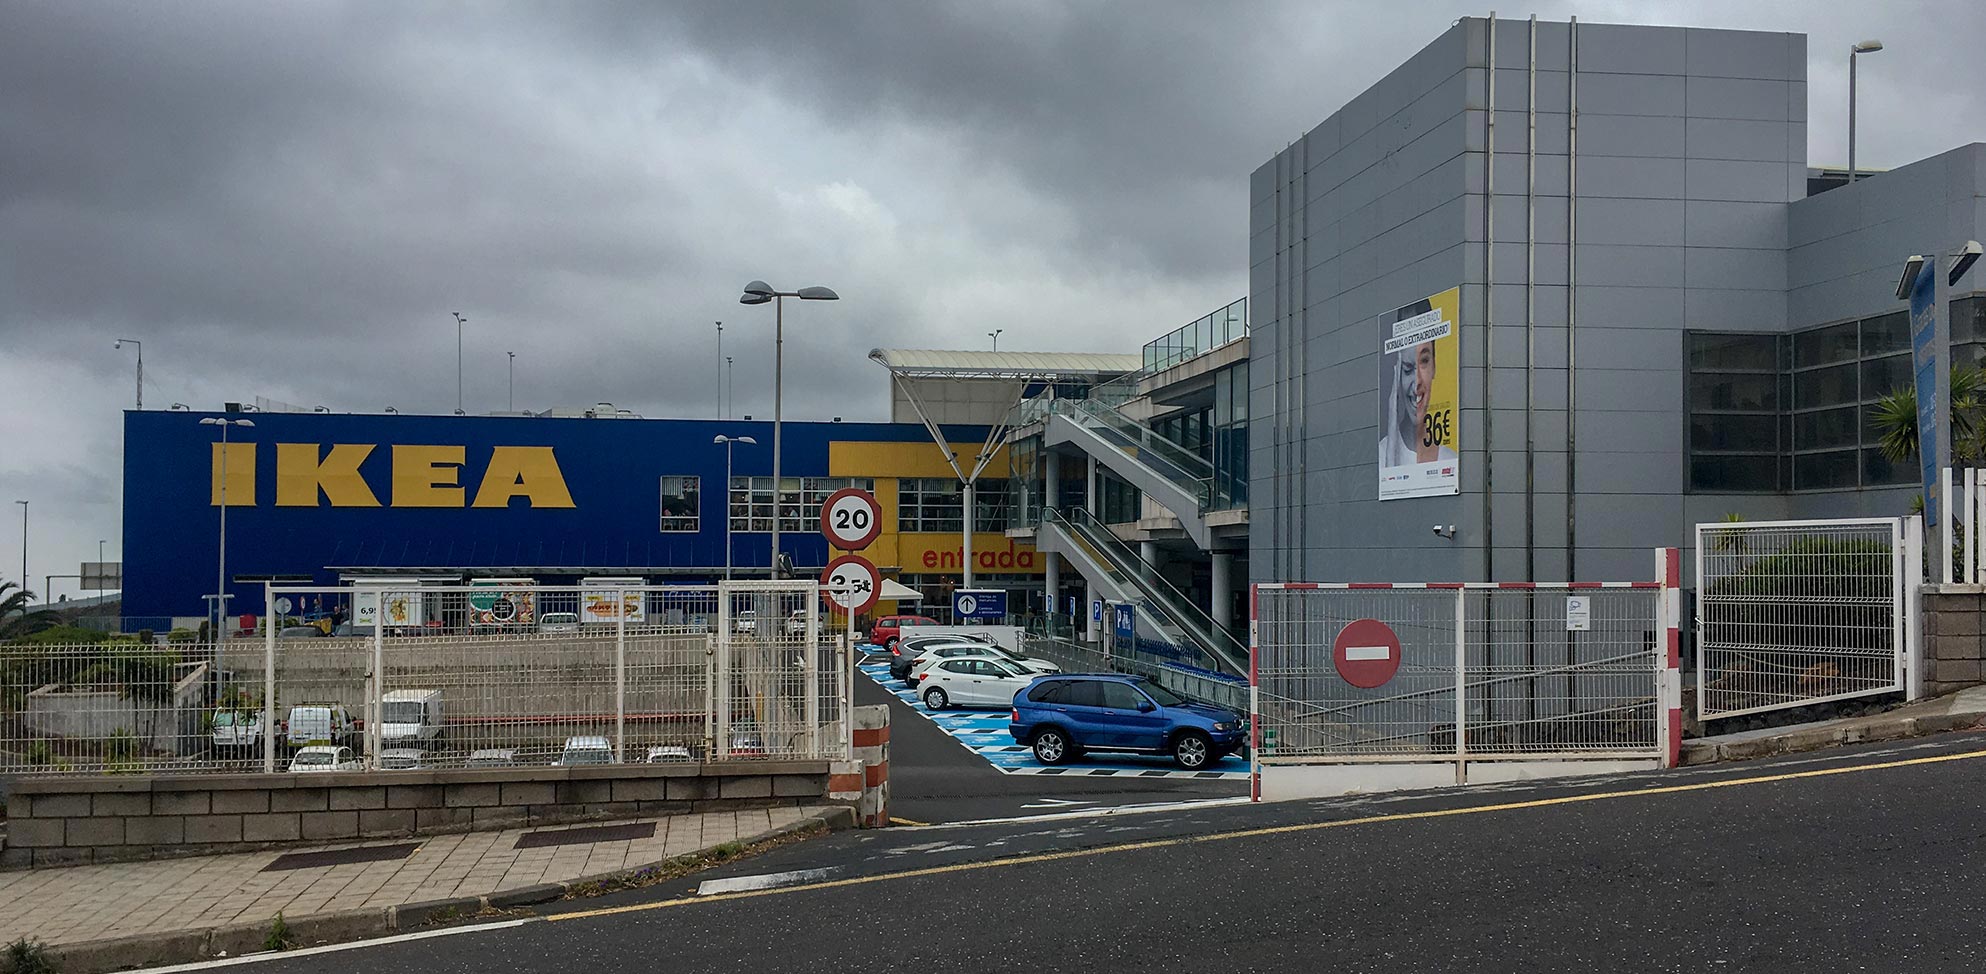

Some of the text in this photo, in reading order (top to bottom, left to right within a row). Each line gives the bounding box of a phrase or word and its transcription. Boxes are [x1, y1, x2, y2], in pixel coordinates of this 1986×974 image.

[1423, 410, 1451, 447] 36€
[211, 442, 577, 508] IKEA
[836, 509, 869, 529] 20
[922, 538, 1034, 568] entrada
[1094, 603, 1100, 618] P
[1117, 609, 1122, 628] P
